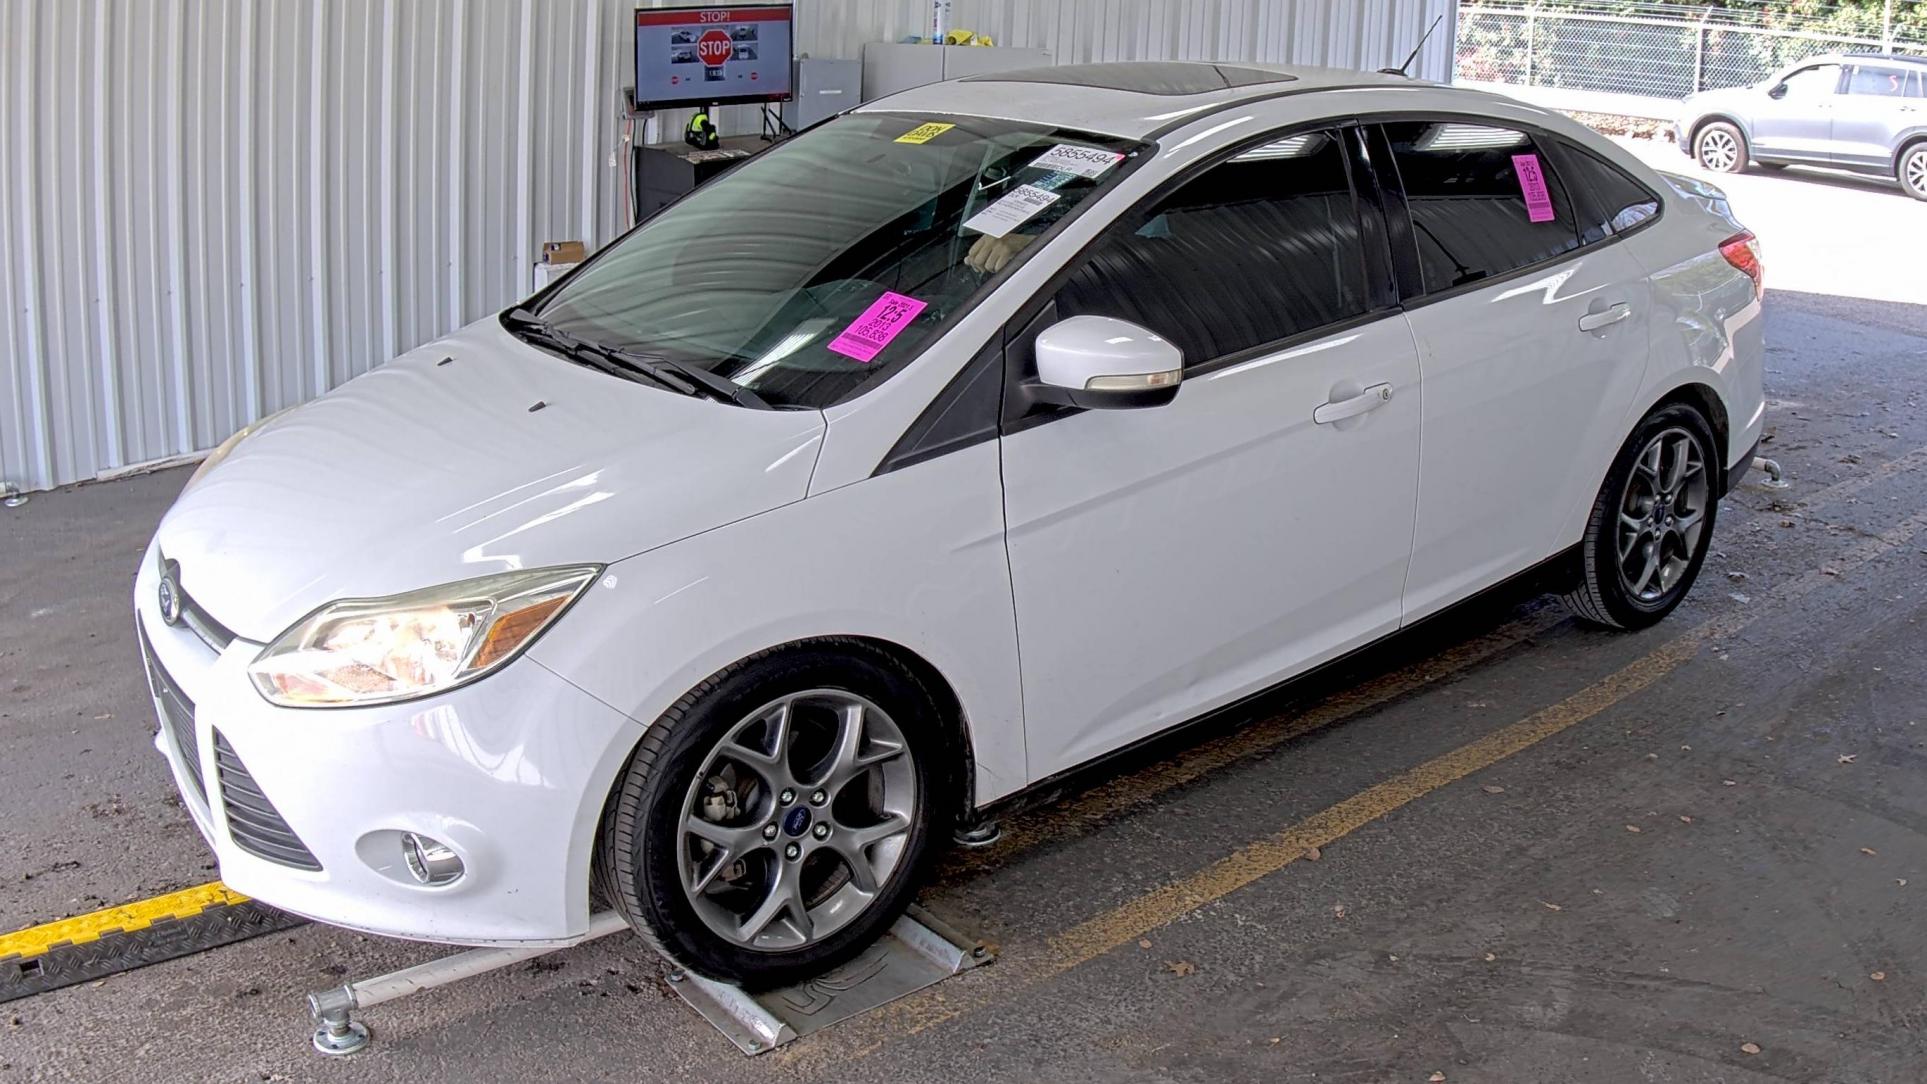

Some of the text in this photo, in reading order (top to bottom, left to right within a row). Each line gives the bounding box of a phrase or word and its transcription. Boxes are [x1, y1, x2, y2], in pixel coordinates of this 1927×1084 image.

[700, 11, 730, 22] STOP!
[700, 41, 730, 56] STOP
[1049, 146, 1115, 165] 5855494
[867, 319, 892, 332] 2013
